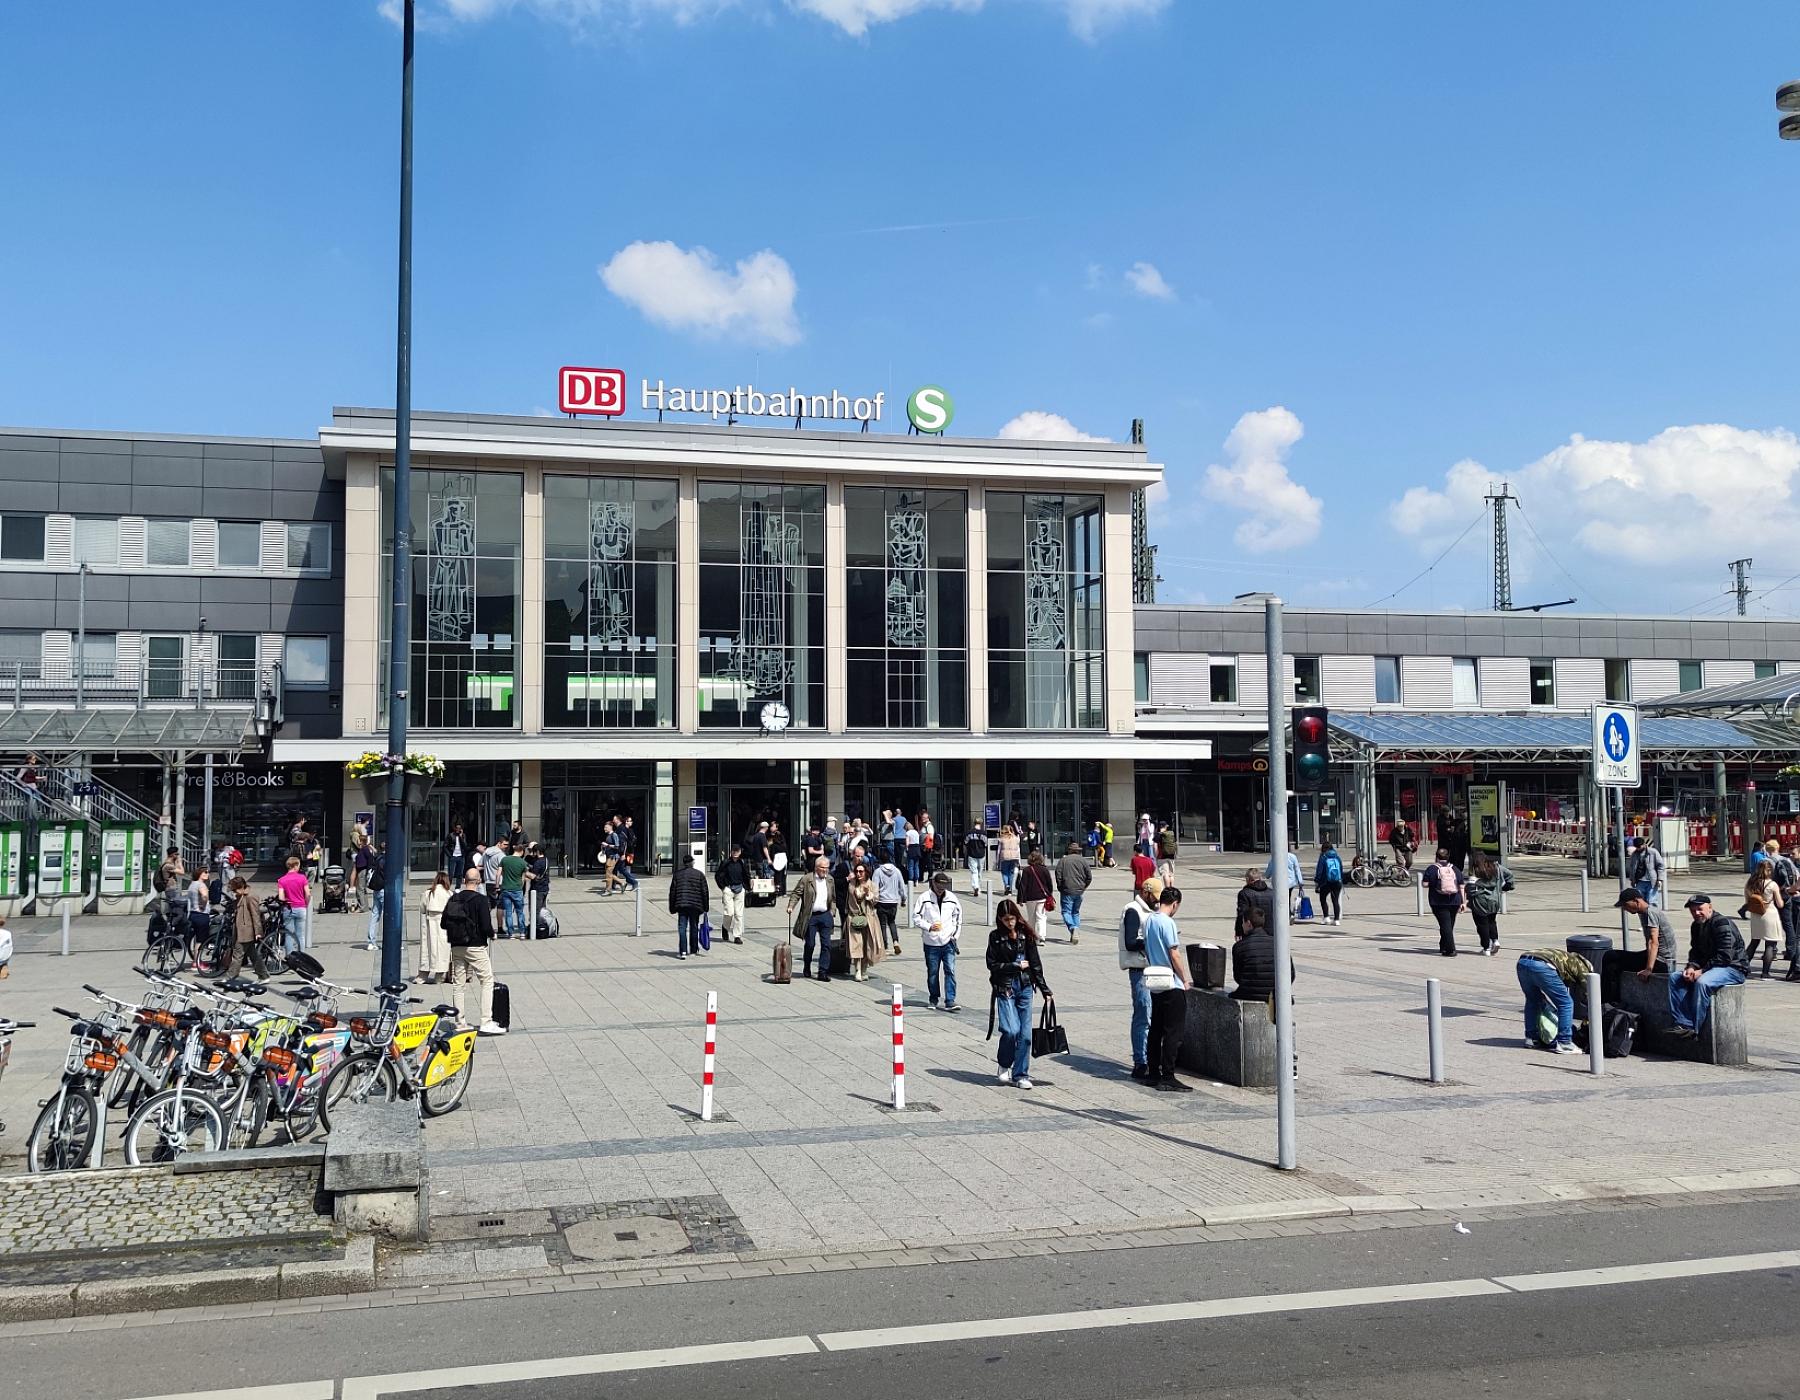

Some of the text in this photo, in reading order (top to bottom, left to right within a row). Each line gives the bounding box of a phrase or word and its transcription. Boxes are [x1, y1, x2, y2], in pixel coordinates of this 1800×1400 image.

[568, 374, 617, 407] DB
[642, 379, 885, 421] Hauptbahnhof
[915, 389, 947, 429] S
[1218, 759, 1252, 771] Kamps
[1608, 765, 1629, 778] ZONE
[402, 1023, 414, 1031] MIT
[402, 1029, 427, 1038] BREMSE
